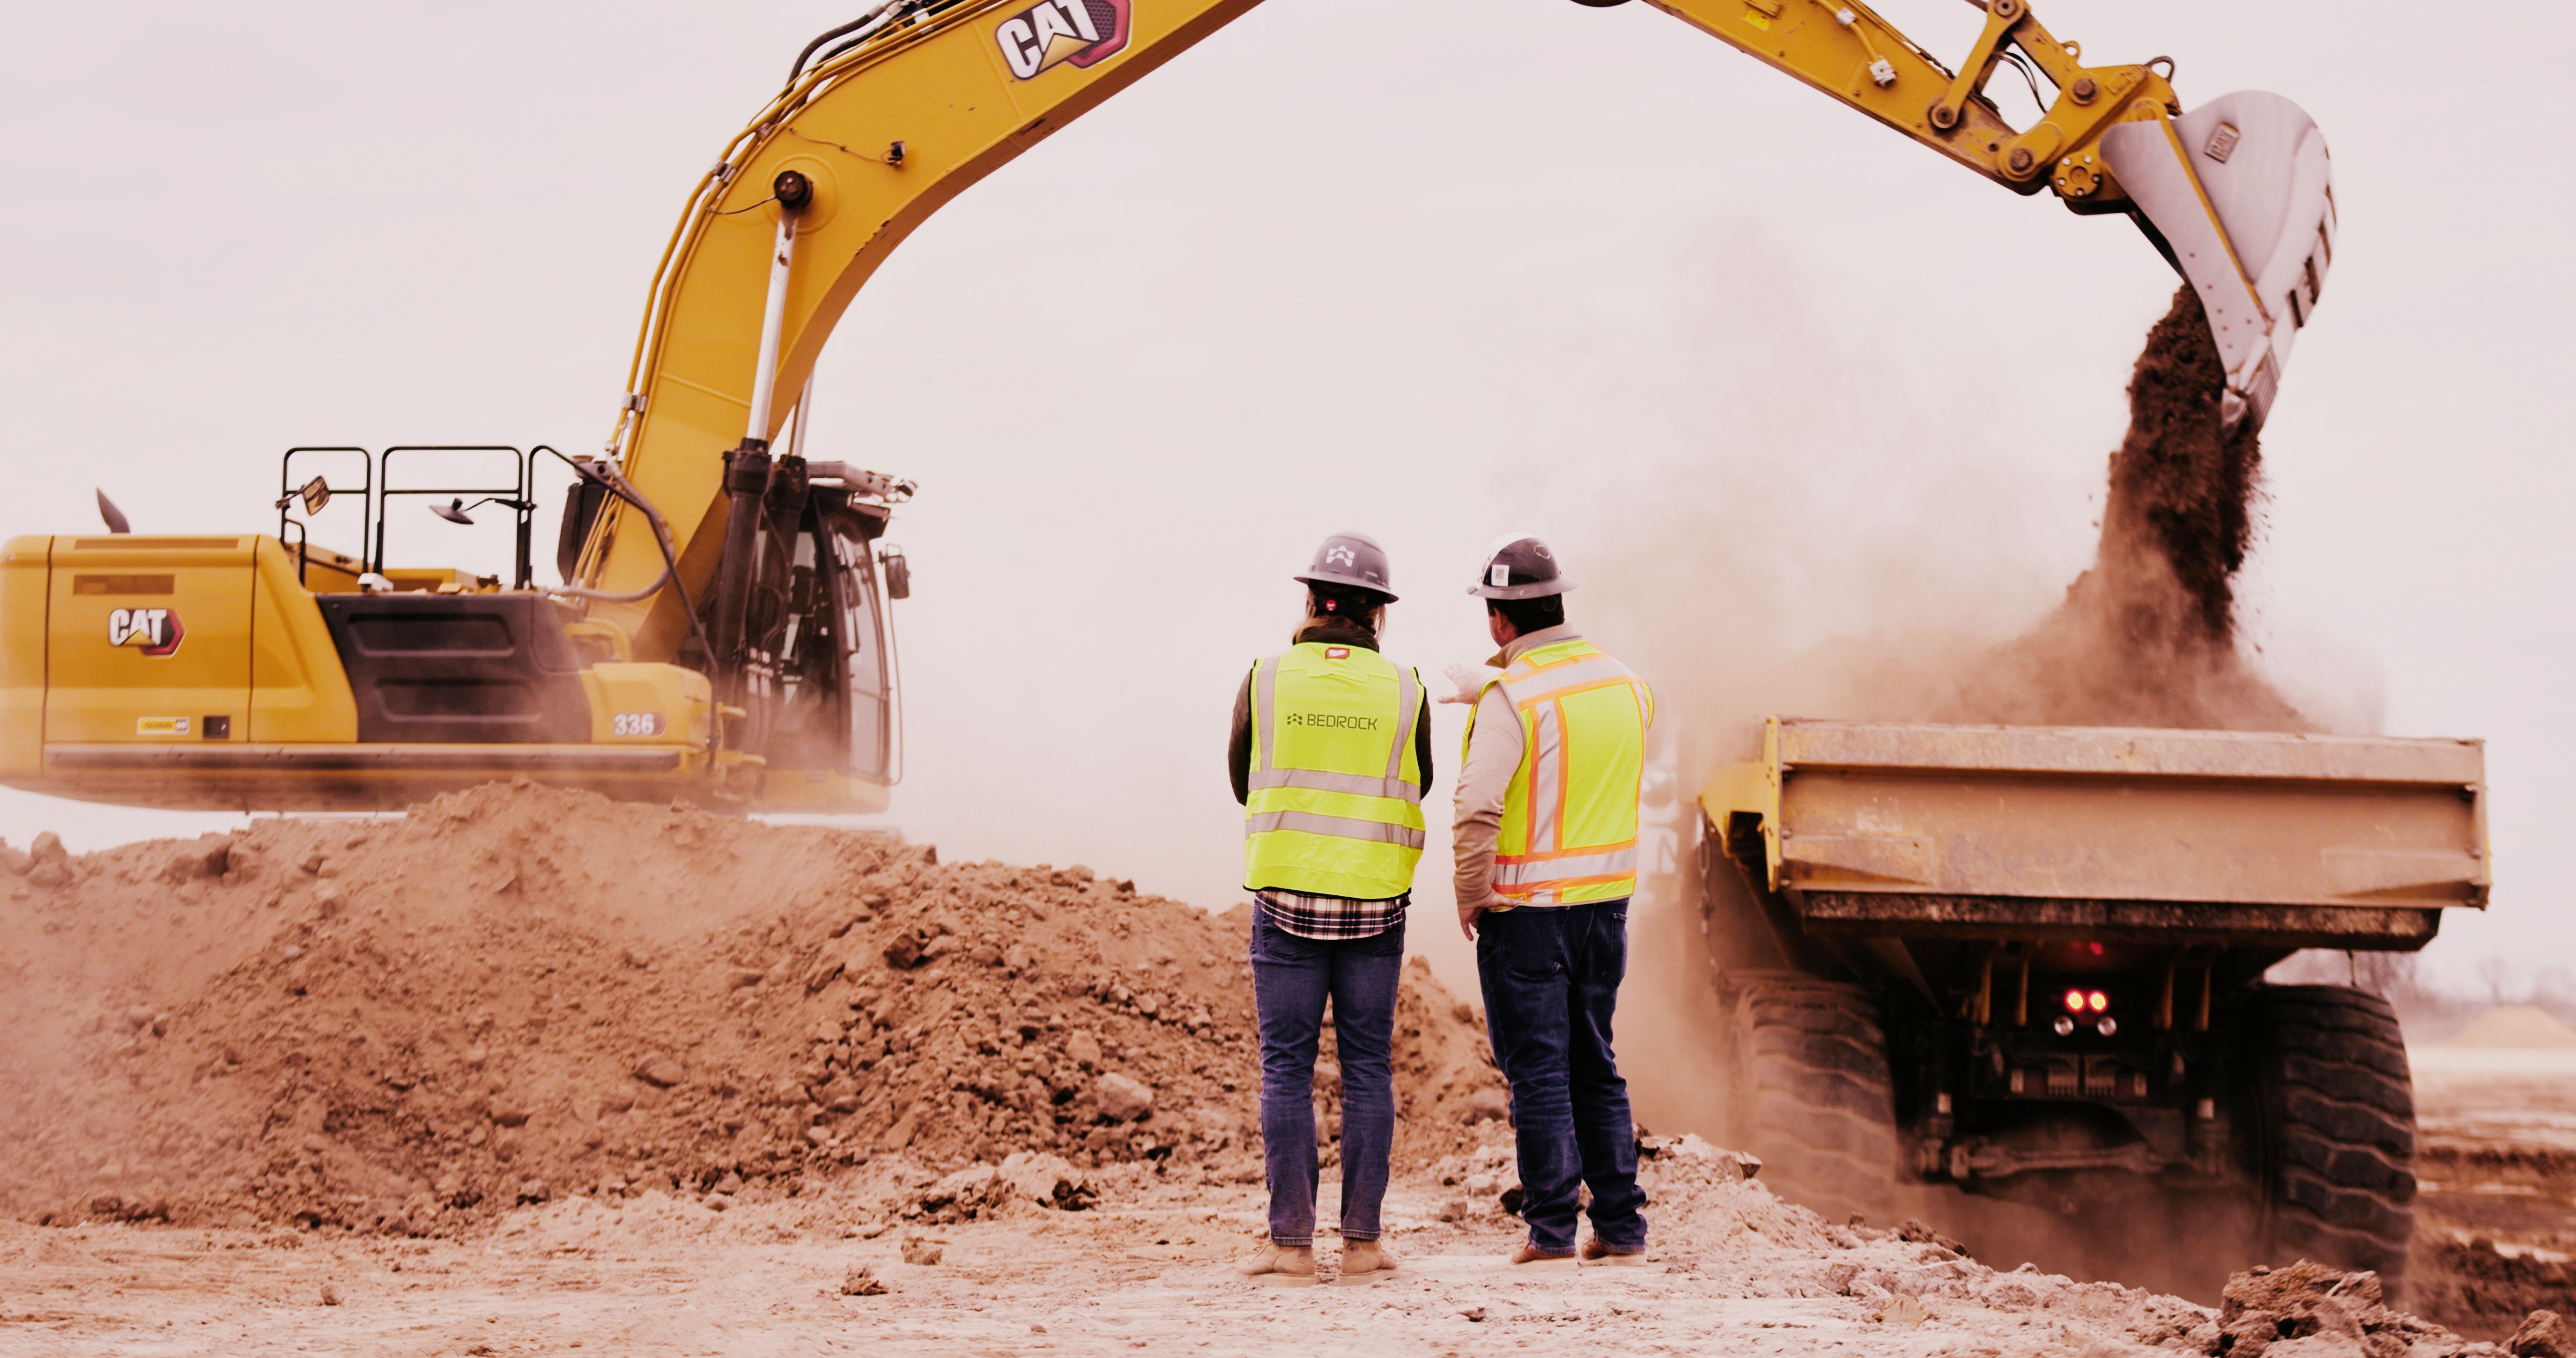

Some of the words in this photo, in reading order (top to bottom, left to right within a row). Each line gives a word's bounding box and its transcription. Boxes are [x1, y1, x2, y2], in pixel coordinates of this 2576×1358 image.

[997, 0, 1100, 78] CAT
[110, 609, 167, 645] CAT
[614, 713, 655, 736] 336
[1307, 714, 1377, 731] BEDROCK
